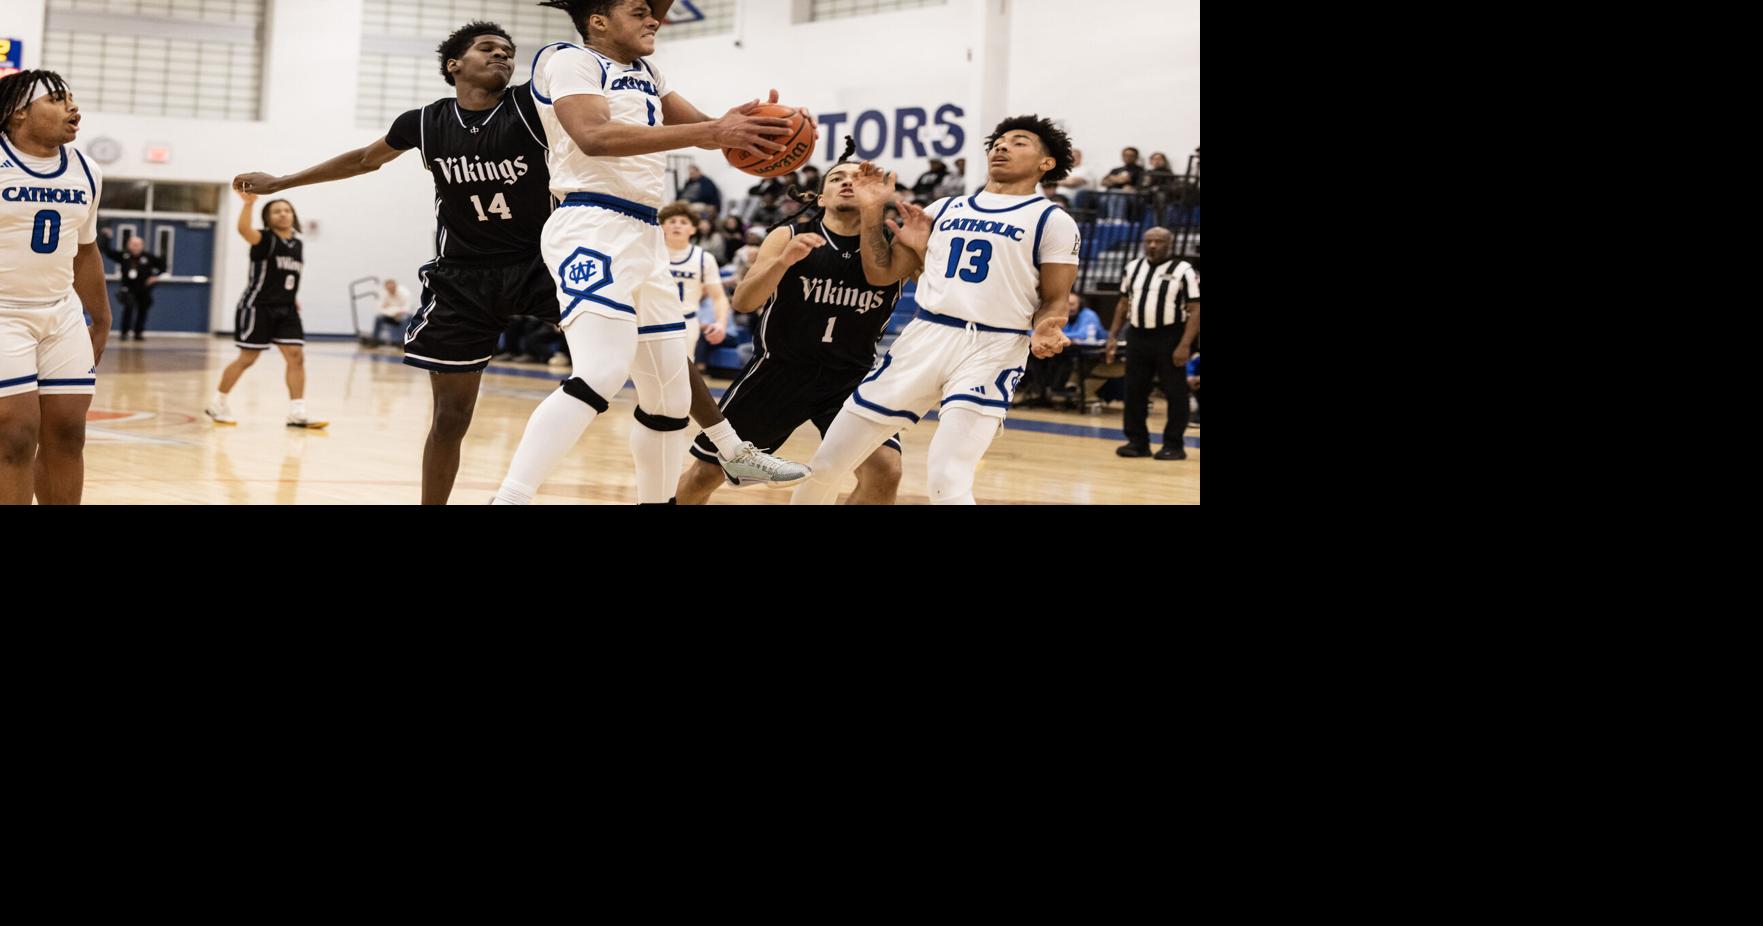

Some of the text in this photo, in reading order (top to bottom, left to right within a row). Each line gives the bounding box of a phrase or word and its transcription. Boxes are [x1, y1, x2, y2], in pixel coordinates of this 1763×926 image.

[818, 103, 965, 161] TORS
[434, 155, 528, 185] Vikings
[1, 186, 88, 205] CATHOLIC
[470, 192, 513, 222] 14
[30, 209, 61, 254] 0
[939, 217, 1025, 242] CATHOLIC
[944, 236, 993, 283] 13
[799, 275, 885, 314] Vikings
[821, 316, 838, 343] 1
